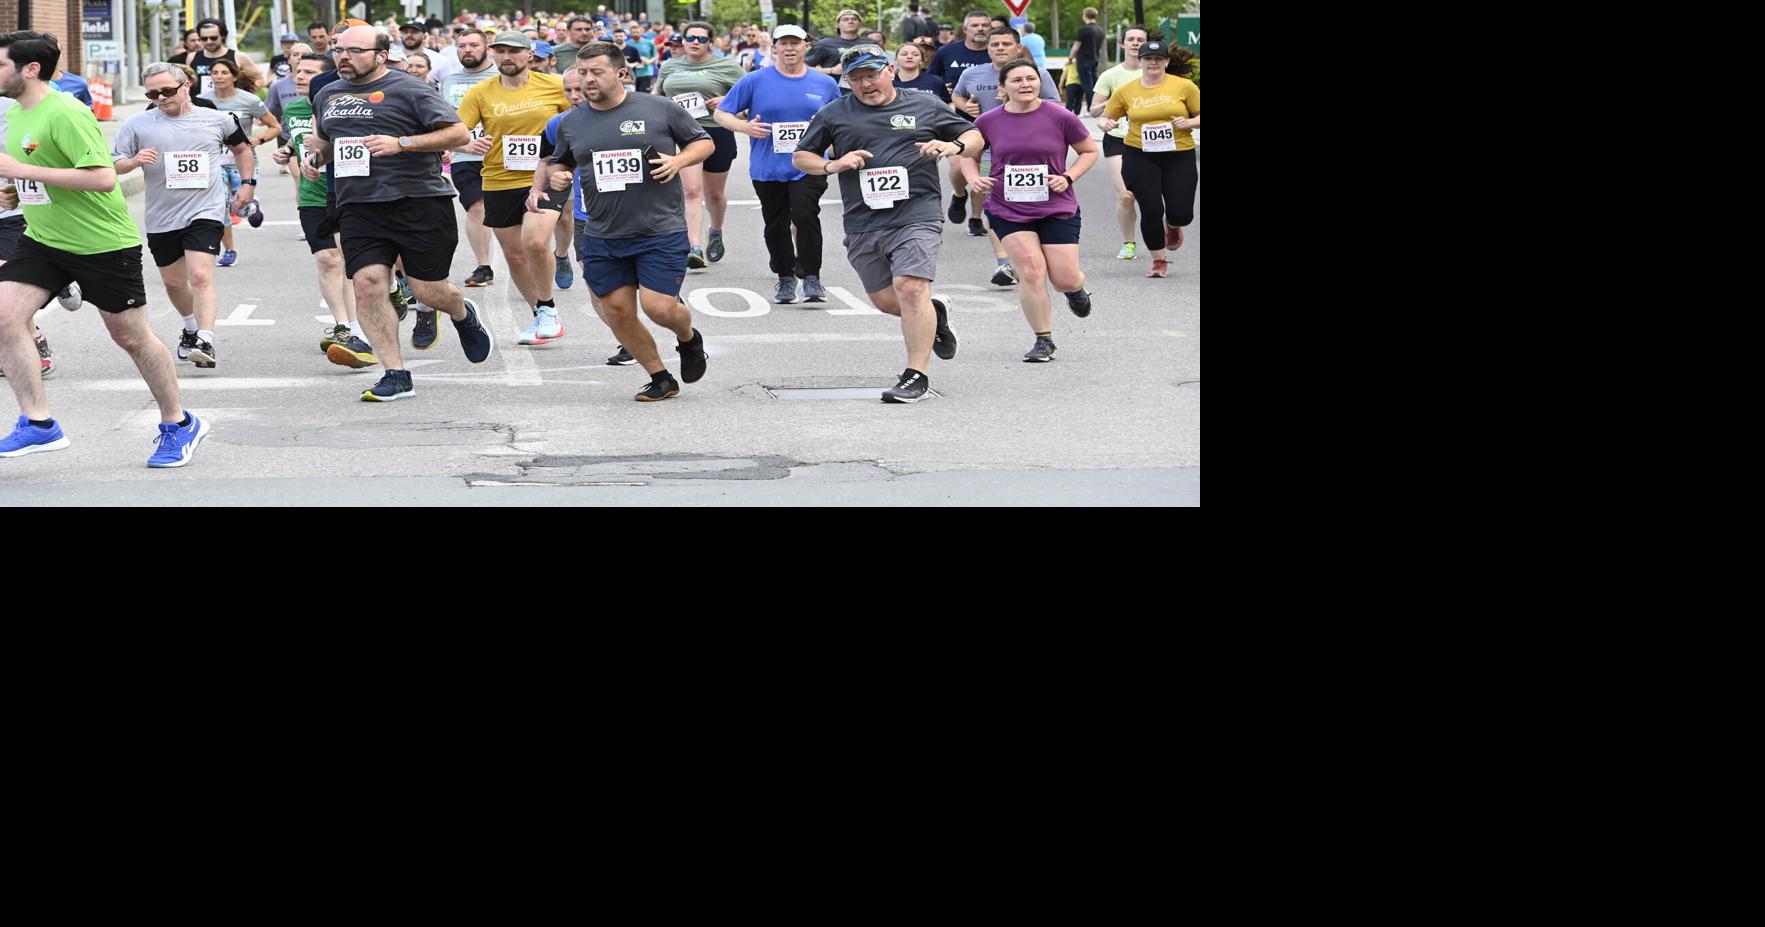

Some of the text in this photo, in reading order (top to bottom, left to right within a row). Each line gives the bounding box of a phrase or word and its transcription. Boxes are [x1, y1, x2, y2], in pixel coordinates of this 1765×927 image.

[976, 84, 998, 92] Ursa
[323, 105, 373, 120] Acadia
[778, 129, 806, 140] 257
[1143, 129, 1173, 140] 1045
[339, 145, 364, 160] 136
[508, 143, 538, 156] 219
[177, 159, 199, 173] 58
[596, 158, 641, 175] 1139
[866, 169, 898, 177] RUNNER
[1006, 173, 1044, 186] 1231
[867, 175, 902, 192] 122
